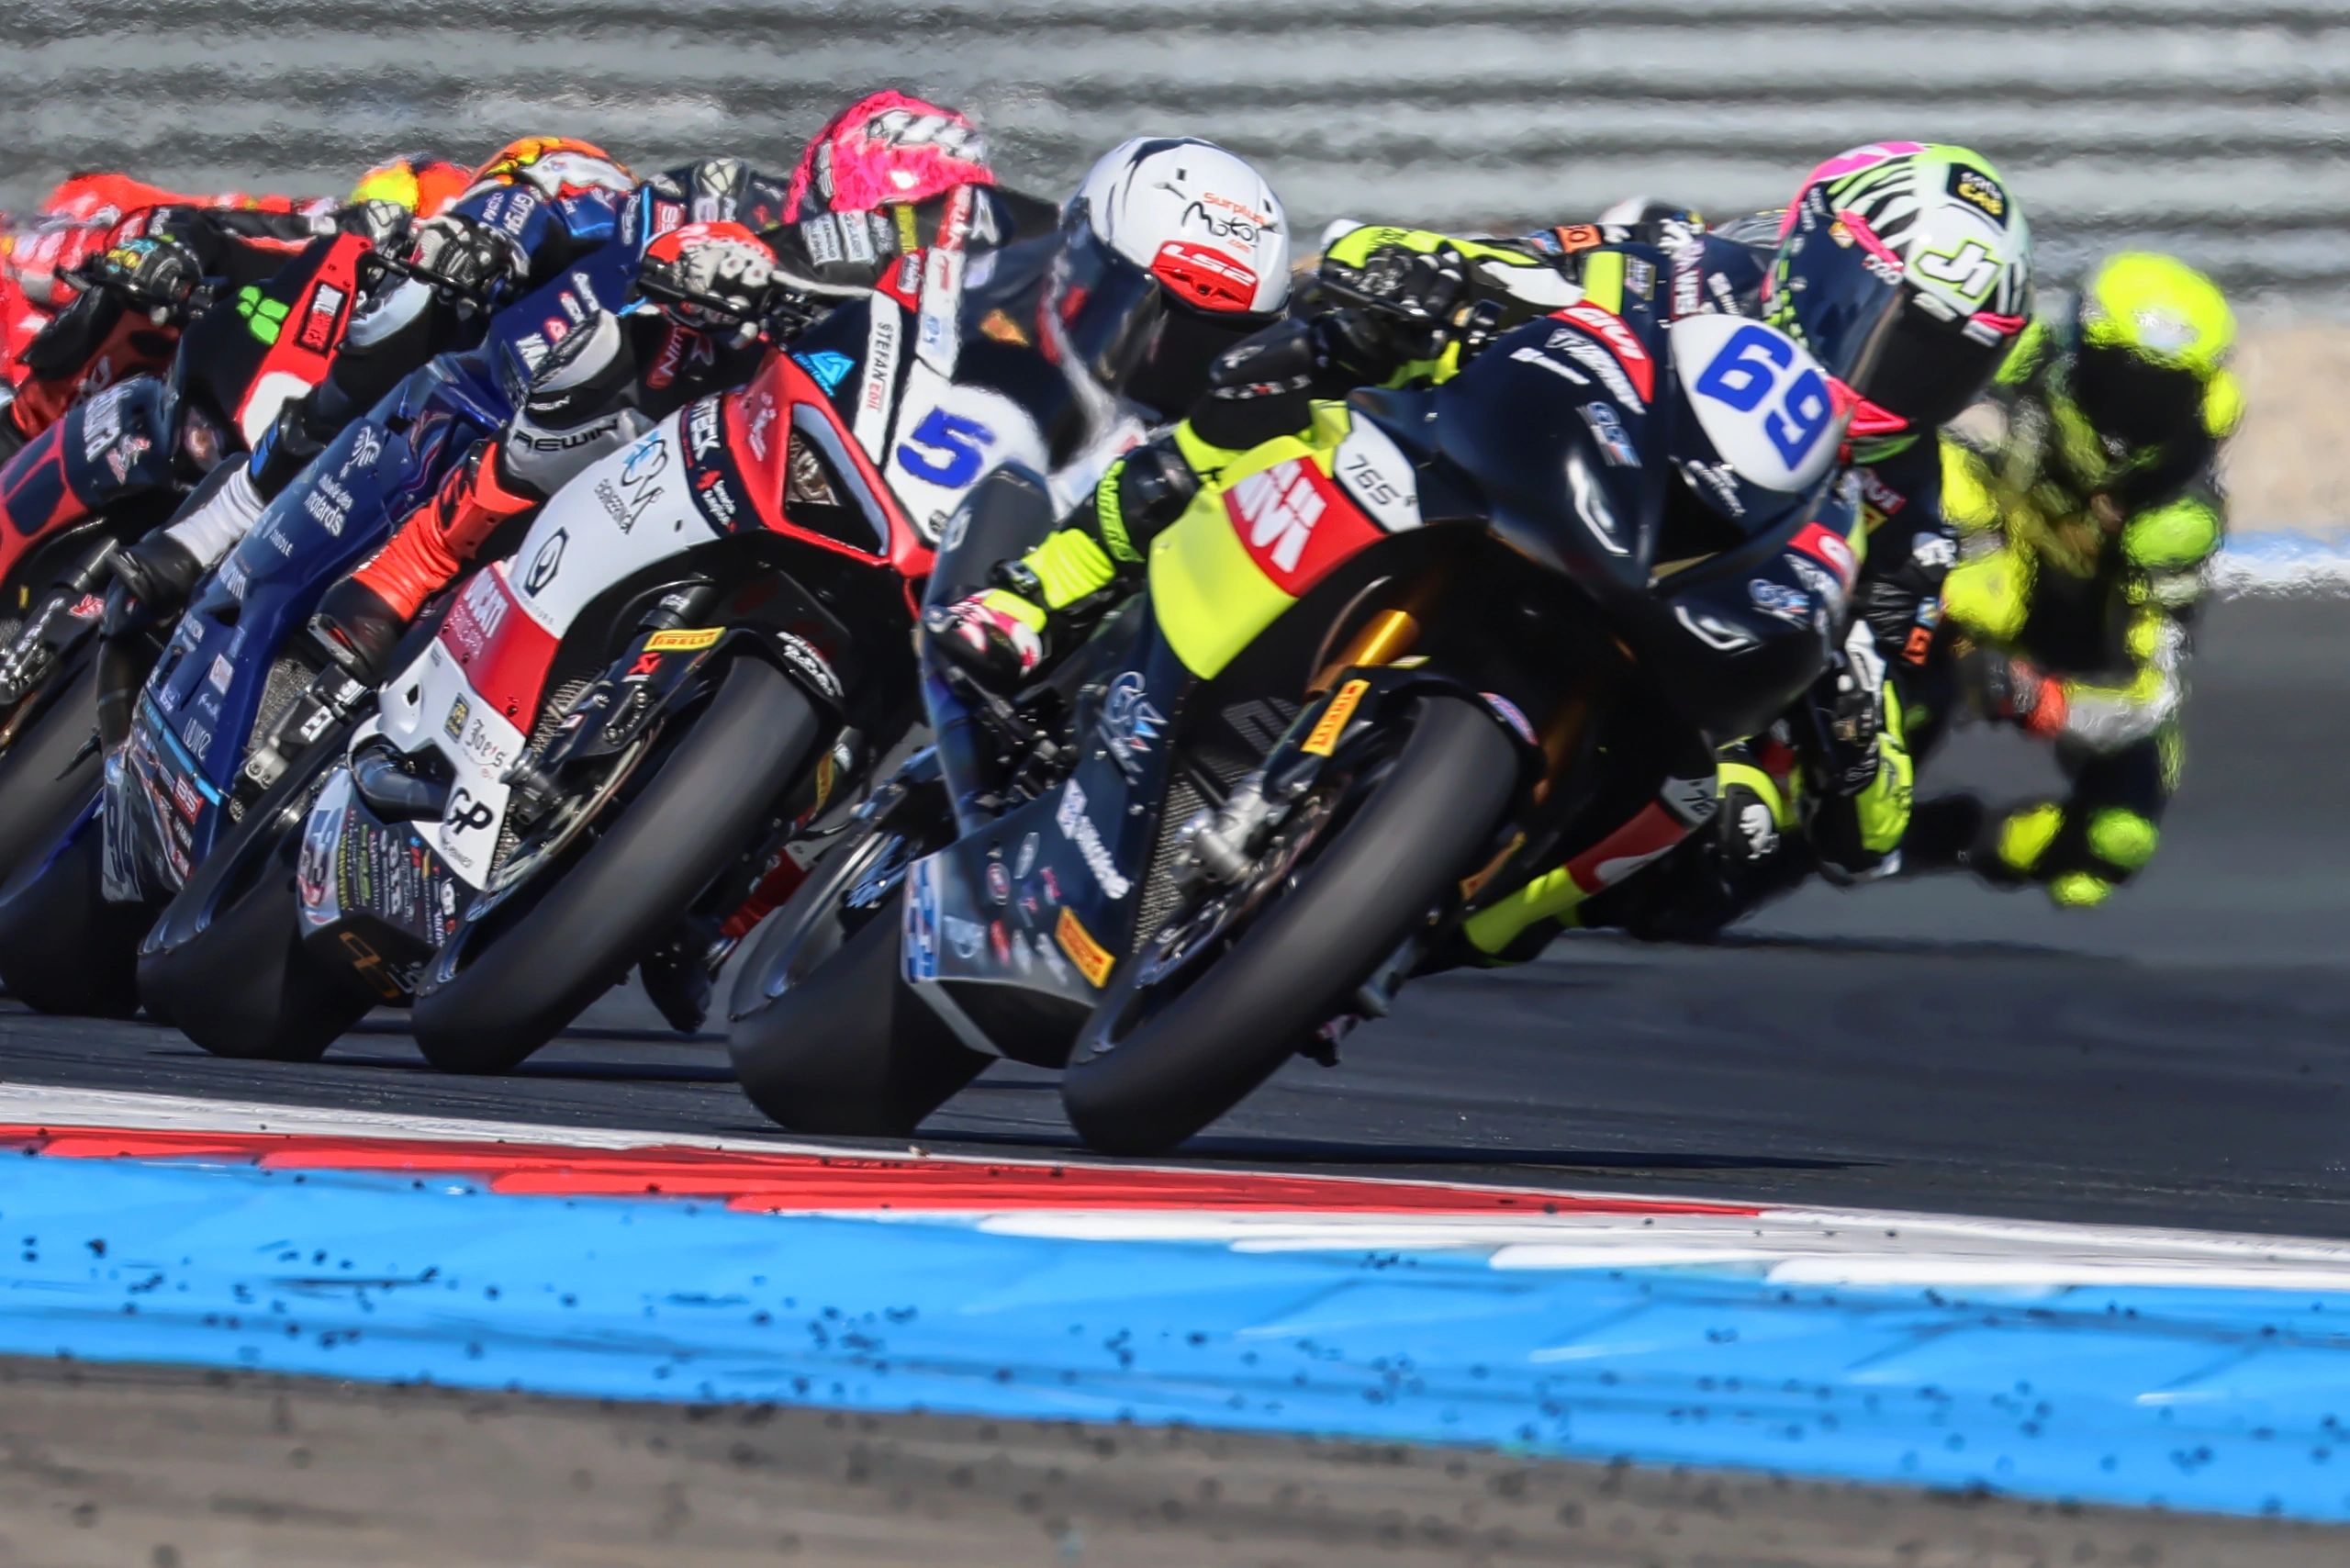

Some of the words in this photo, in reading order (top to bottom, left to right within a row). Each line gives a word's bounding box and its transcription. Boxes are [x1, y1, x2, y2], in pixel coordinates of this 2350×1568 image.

[1159, 243, 1259, 287] LS2
[870, 321, 892, 385] STEFAN
[1697, 325, 1833, 471] 69
[897, 406, 996, 488] 5
[1345, 454, 1401, 507] 765
[653, 629, 720, 646] PIRELLI
